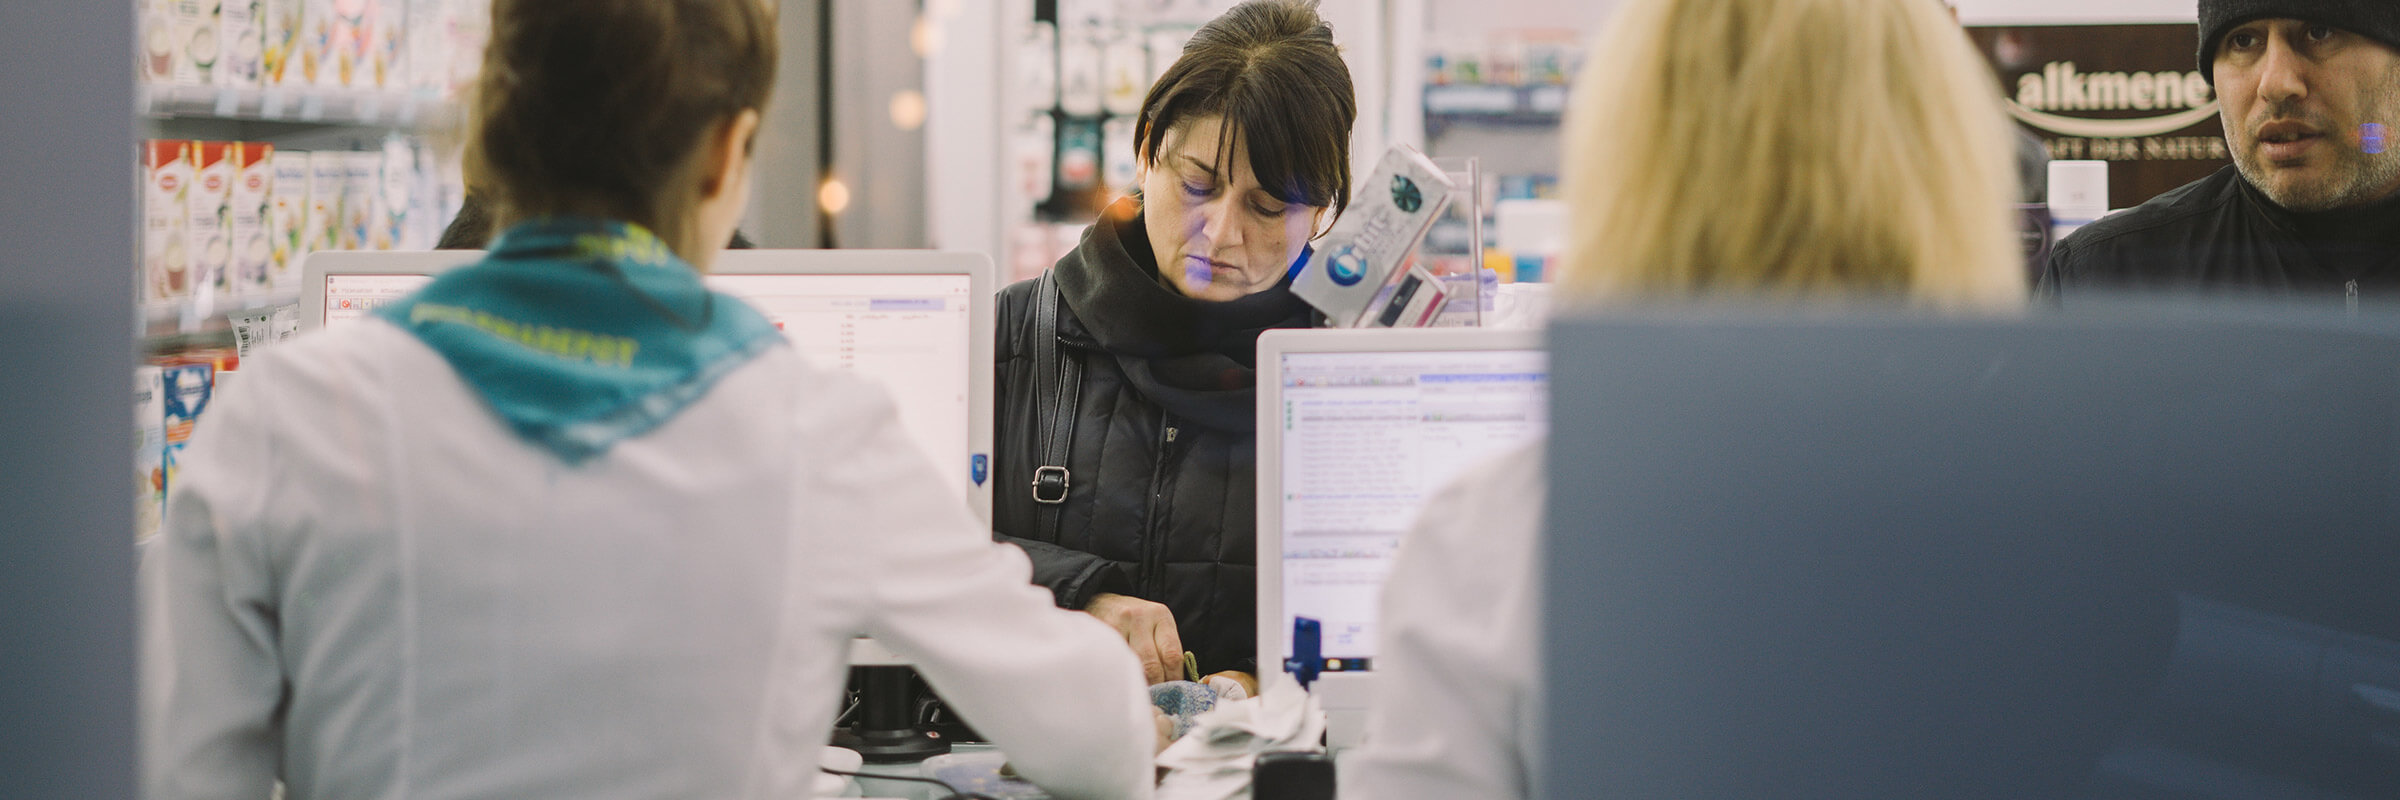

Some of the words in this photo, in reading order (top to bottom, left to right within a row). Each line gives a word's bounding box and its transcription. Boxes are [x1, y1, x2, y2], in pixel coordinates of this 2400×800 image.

[2016, 61, 2212, 110] alkmene
[2089, 137, 2140, 161] DER
[2143, 136, 2226, 160] NATUR
